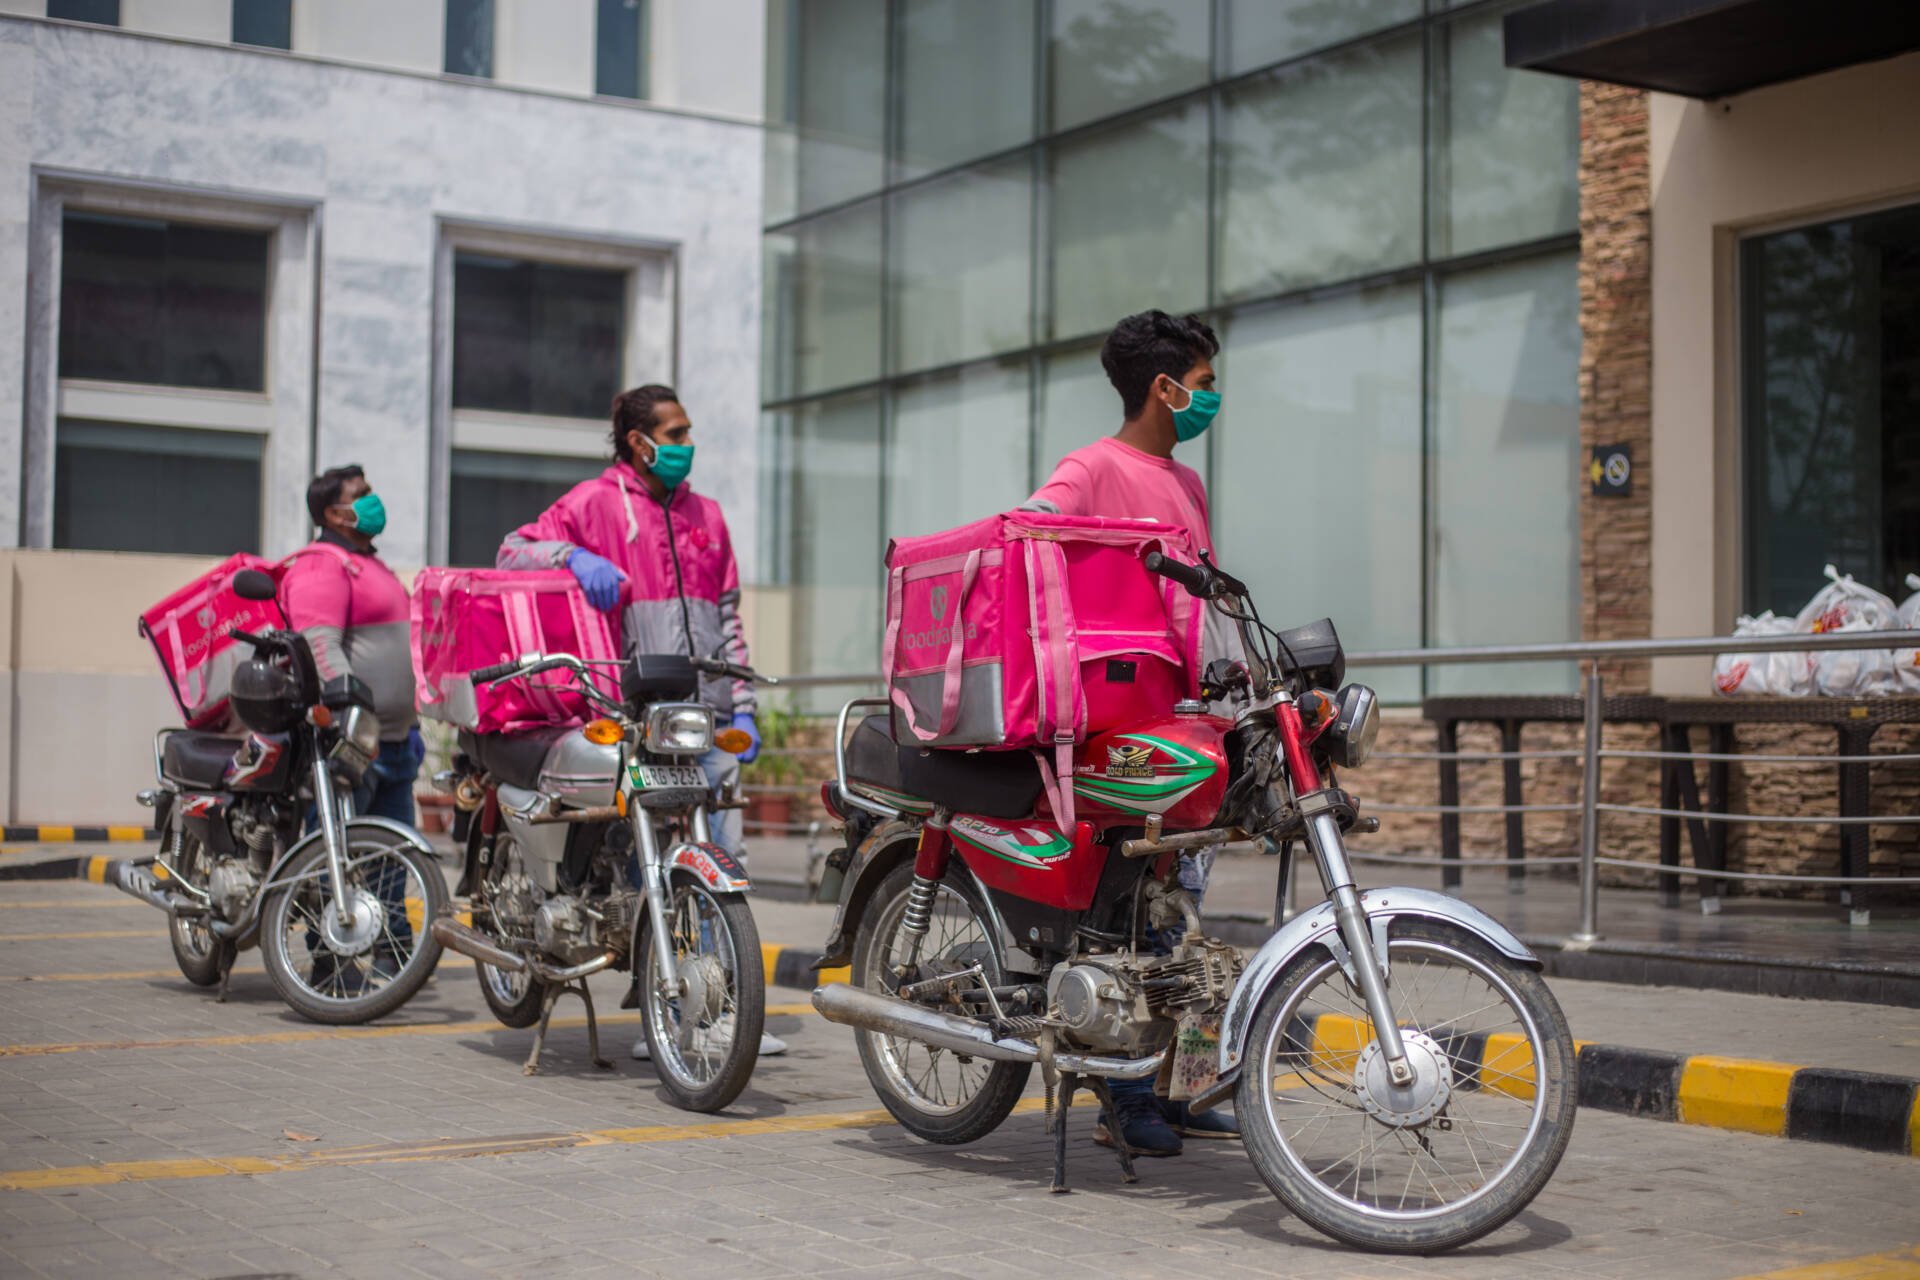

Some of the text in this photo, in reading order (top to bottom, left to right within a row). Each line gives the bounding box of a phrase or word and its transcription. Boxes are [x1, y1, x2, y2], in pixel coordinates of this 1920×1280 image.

[669, 767, 703, 786] 5231
[1106, 766, 1123, 777] ROAD
[1125, 766, 1153, 777] PRINCE
[1043, 851, 1071, 863] euro2
